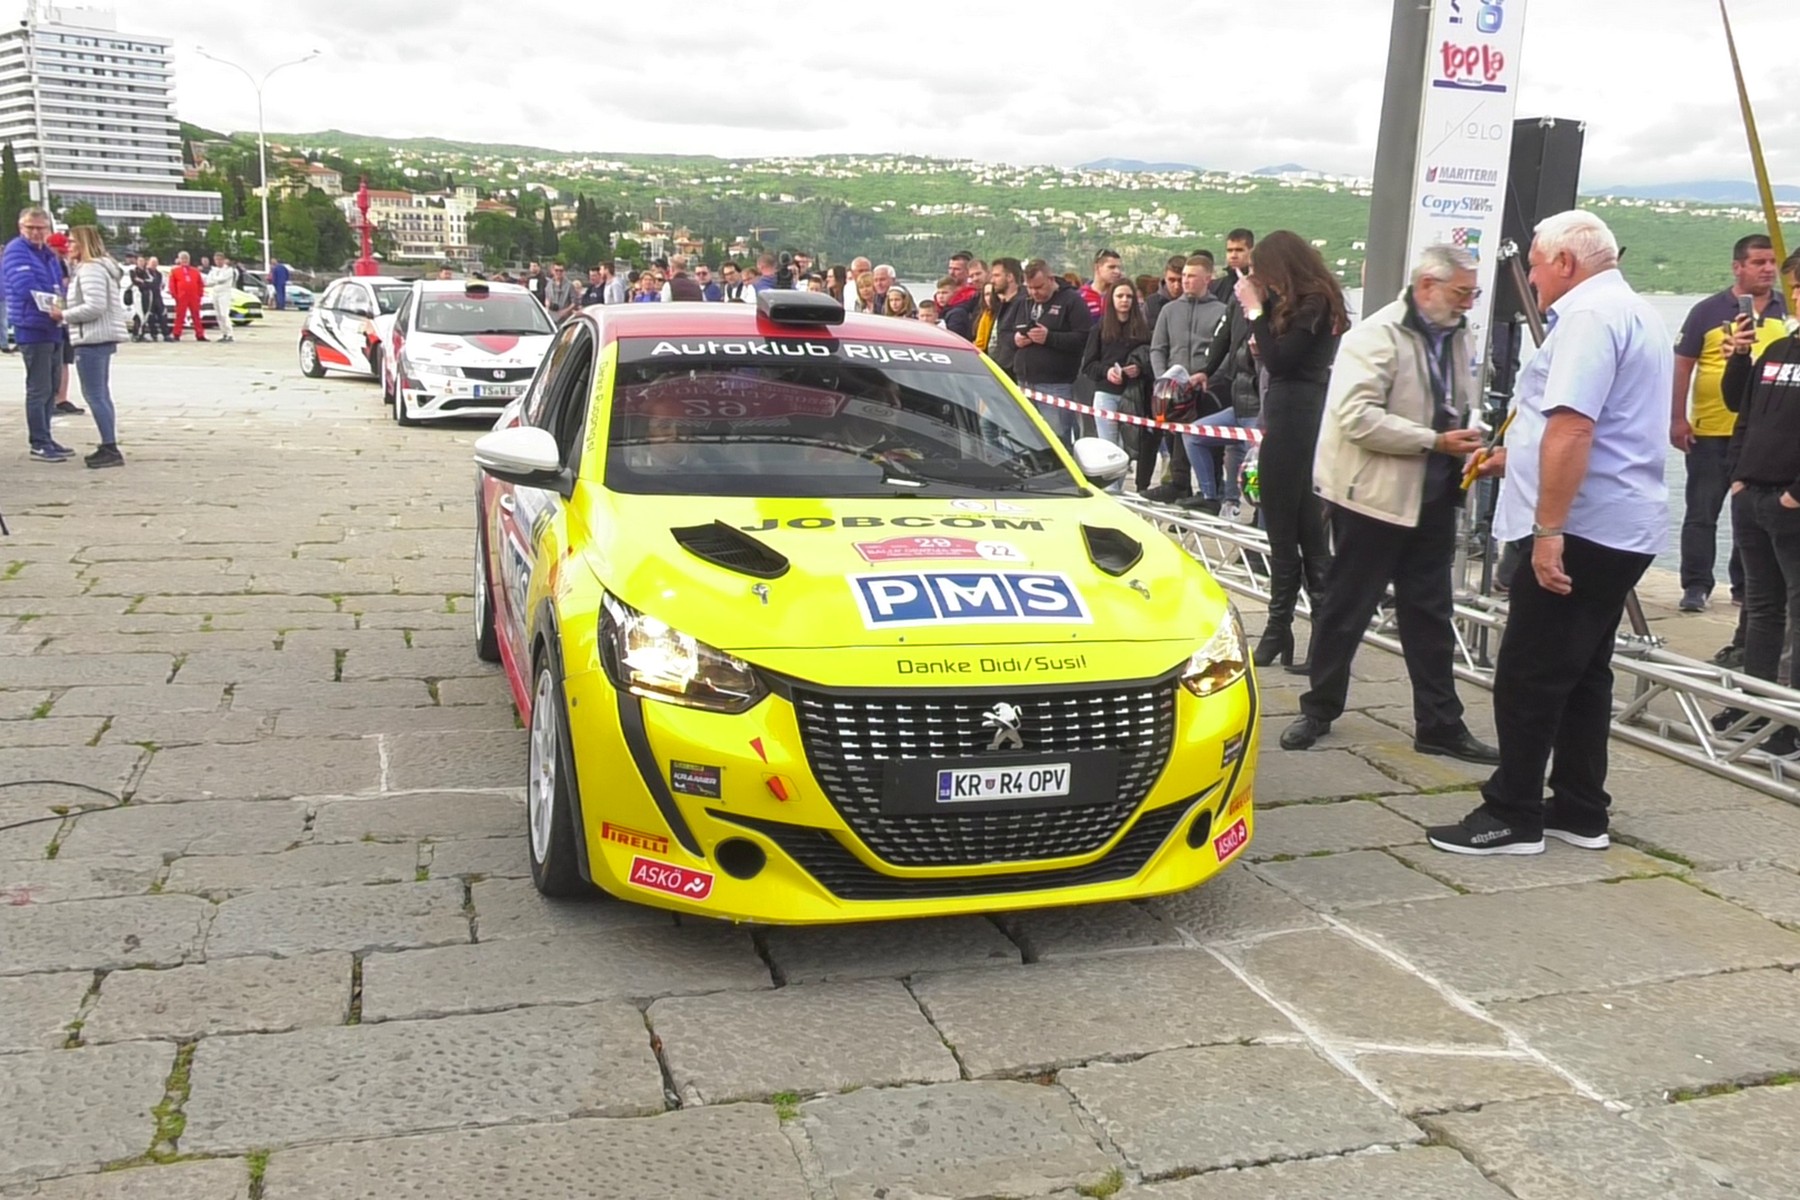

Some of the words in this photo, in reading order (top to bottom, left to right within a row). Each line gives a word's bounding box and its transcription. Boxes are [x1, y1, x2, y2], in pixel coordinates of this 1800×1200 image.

[1439, 166, 1498, 182] MARITERM
[650, 340, 830, 357] Autoklub
[843, 343, 952, 365] Rijeka
[740, 516, 1045, 532] JOBCOM
[913, 538, 952, 548] 29
[984, 544, 1016, 557] 22
[867, 577, 1068, 615] PMS
[897, 659, 972, 674] Danke
[955, 774, 981, 797] KR
[1001, 771, 1023, 794] R4
[1029, 769, 1065, 792] OPV
[601, 821, 669, 855] PIRELLI
[635, 864, 681, 888] ASKÖ
